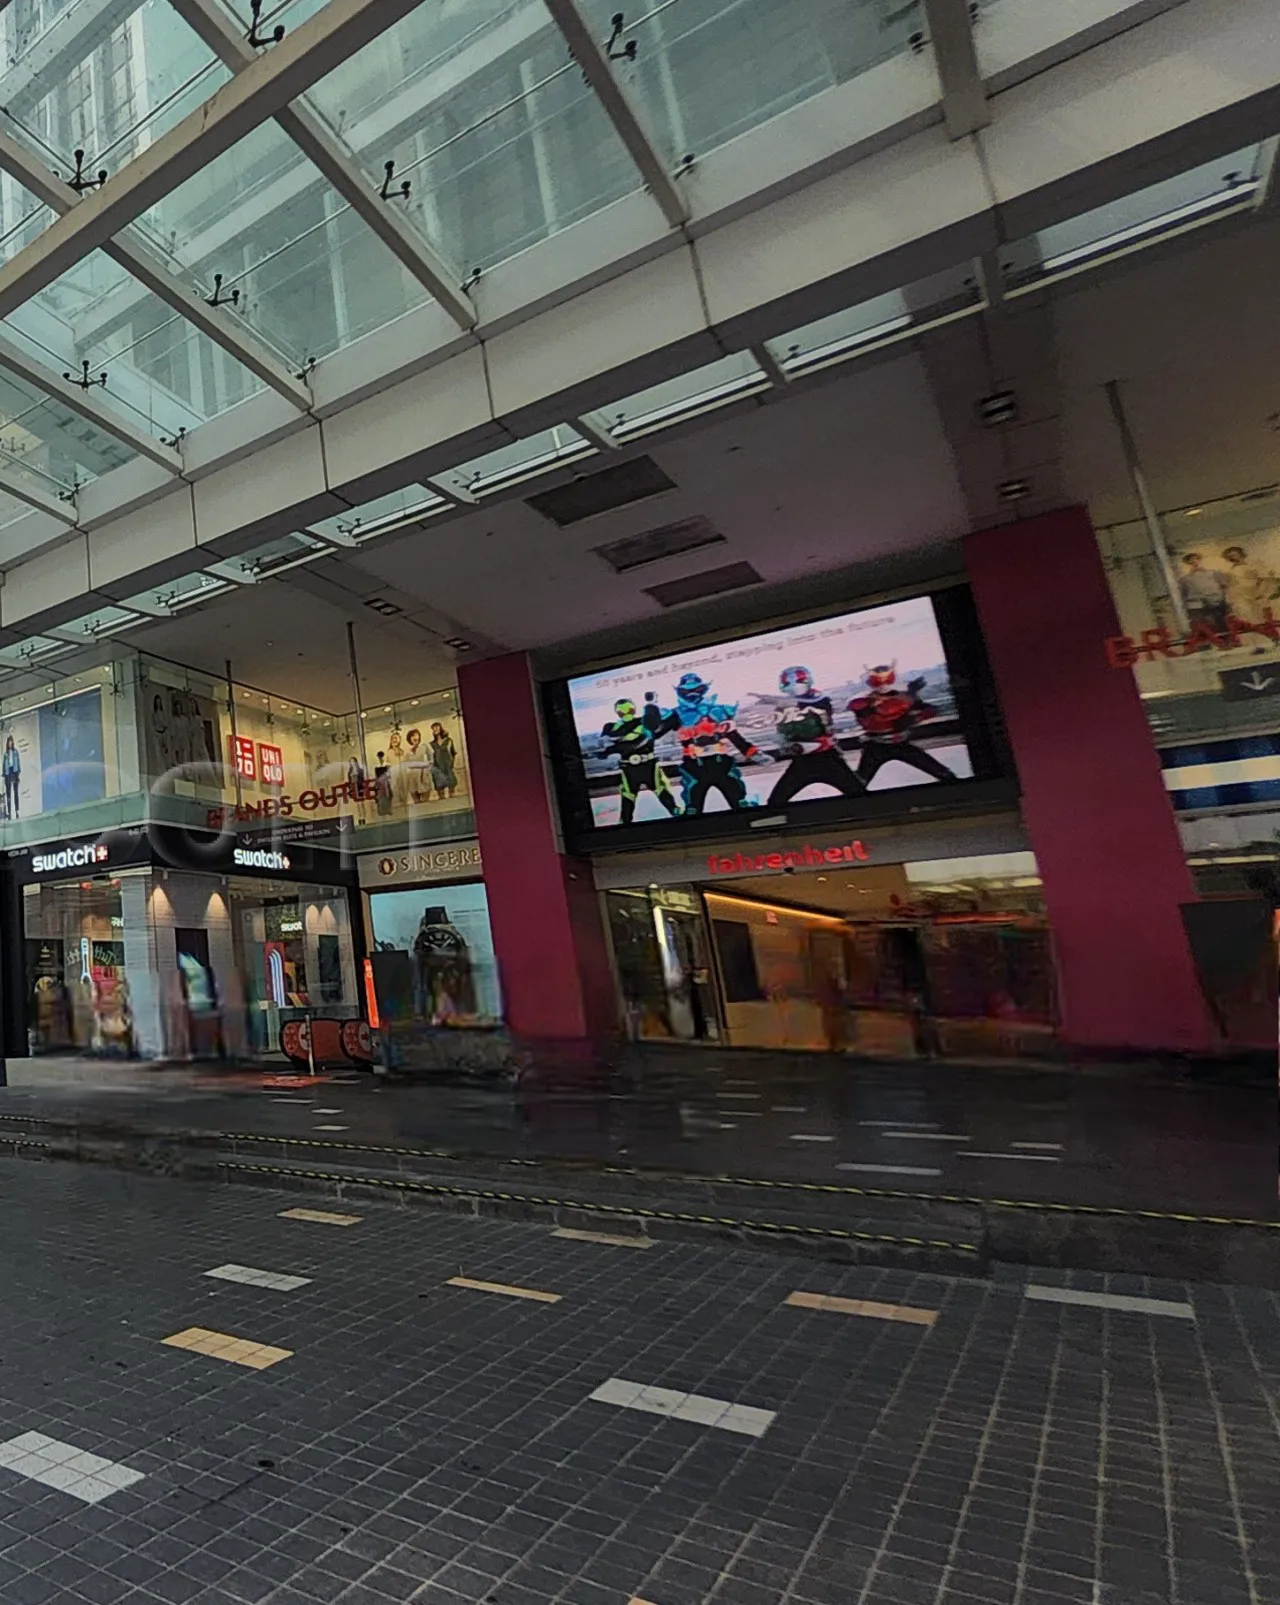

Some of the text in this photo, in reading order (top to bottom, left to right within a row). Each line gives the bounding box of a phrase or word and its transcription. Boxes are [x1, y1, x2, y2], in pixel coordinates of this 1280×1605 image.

[613, 672, 644, 687] years
[647, 663, 669, 678] and
[820, 627, 845, 639] the
[261, 747, 280, 765] UNI
[263, 764, 282, 782] QLO
[299, 777, 378, 811] OUTLE
[32, 844, 97, 873] swatch
[233, 848, 283, 870] swatch
[400, 847, 482, 872] SINCERE
[706, 840, 869, 874] fahrenheit
